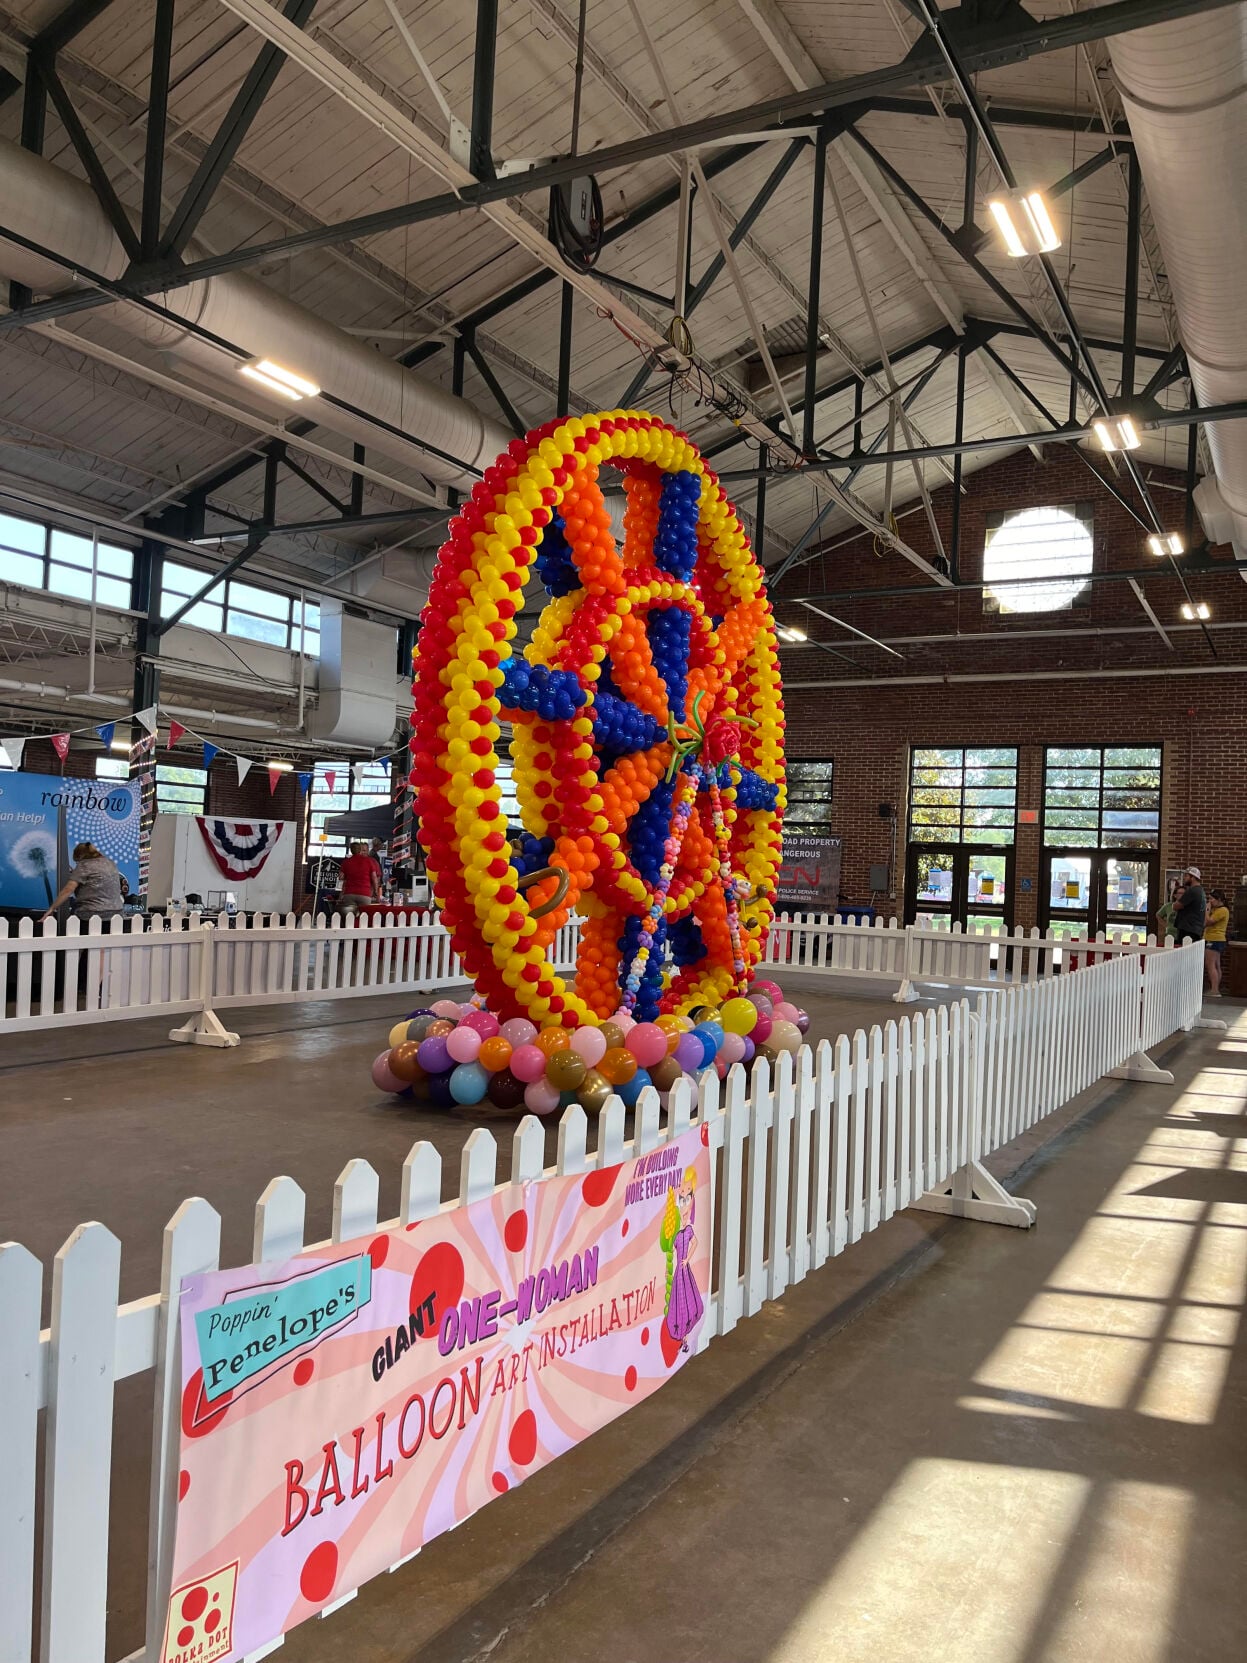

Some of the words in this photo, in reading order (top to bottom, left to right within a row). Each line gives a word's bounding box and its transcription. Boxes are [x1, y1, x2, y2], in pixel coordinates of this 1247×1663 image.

[41, 788, 127, 812] rainbow
[0, 812, 16, 822] an
[17, 812, 46, 825] Help!
[780, 849, 821, 858] ANGEROUS
[800, 838, 841, 847] PROPERTY
[633, 1156, 648, 1178] I'M
[646, 1146, 680, 1174] BUILDING
[625, 1179, 644, 1206] MORE
[209, 1296, 278, 1338] Poppin'
[372, 1291, 437, 1382] GIANT
[438, 1246, 600, 1357] ONE-WOMAN
[206, 1283, 355, 1390] Penelope's
[281, 1356, 484, 1537] BALLOON
[490, 1342, 533, 1397] ART
[537, 1276, 657, 1371] INSTALLATION
[208, 1627, 228, 1648] DOT
